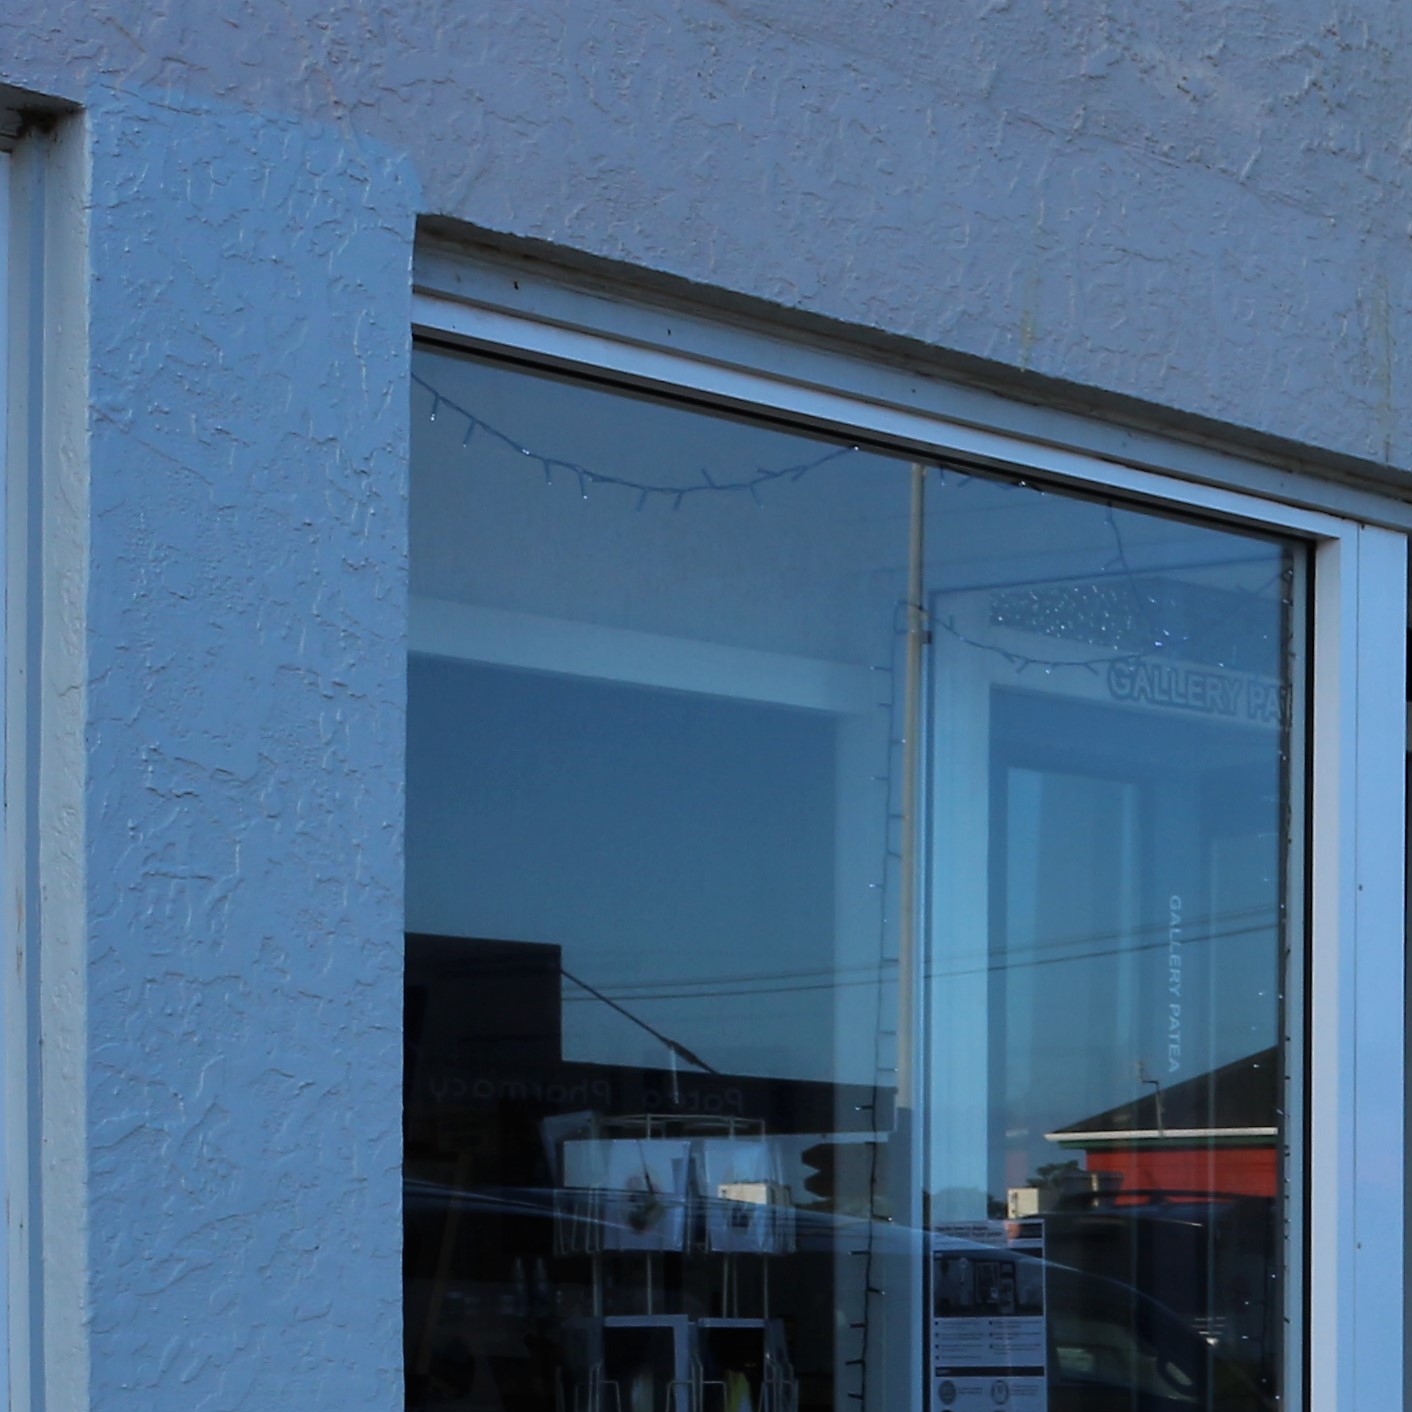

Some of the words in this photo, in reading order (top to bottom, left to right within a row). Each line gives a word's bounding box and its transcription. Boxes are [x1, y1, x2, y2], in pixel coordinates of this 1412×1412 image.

[1108, 659, 1243, 717] GALLERY
[1168, 895, 1182, 997] GALLERY
[1168, 1003, 1181, 1073] PATEA
